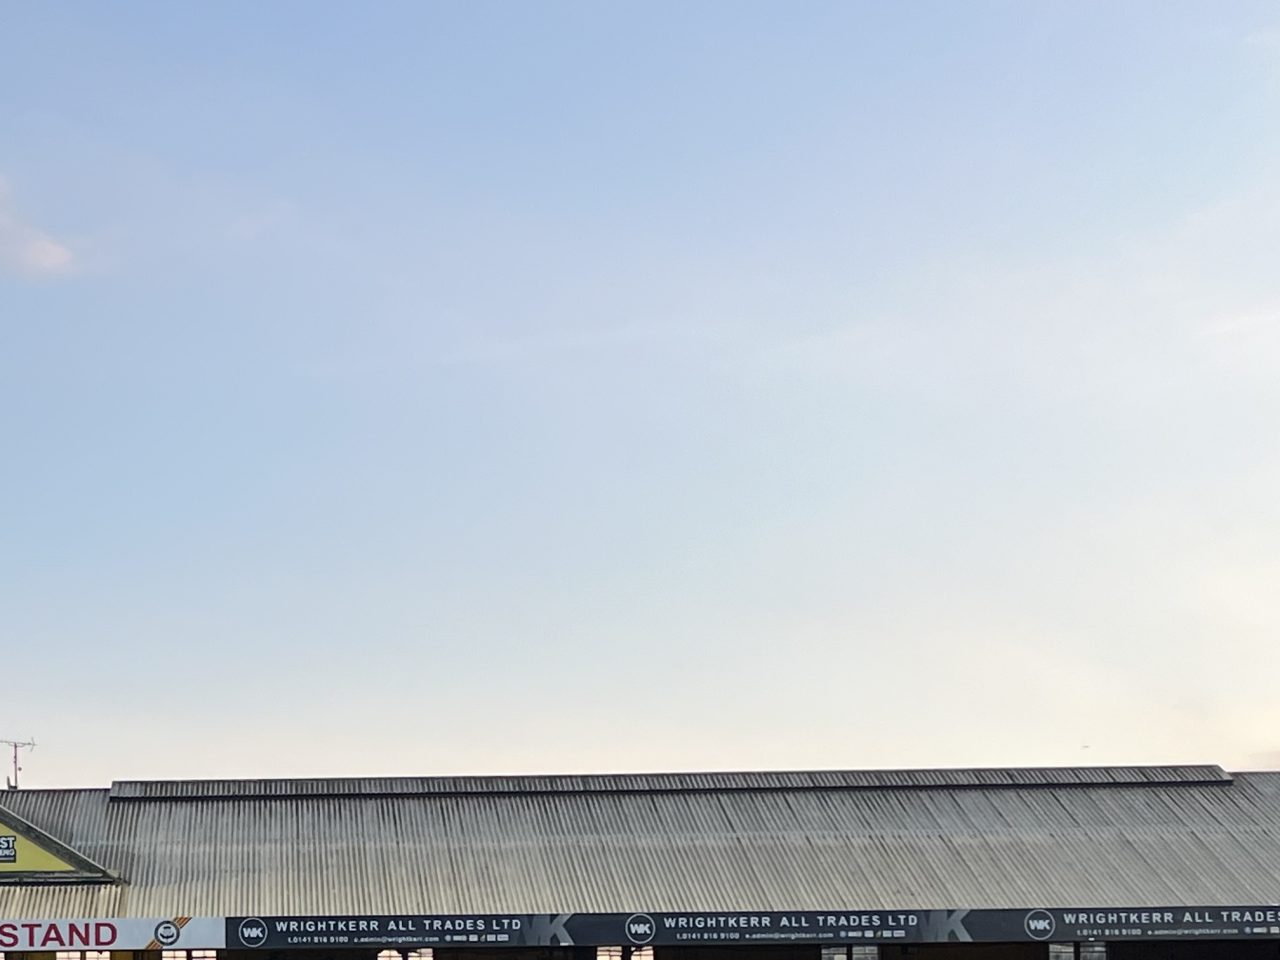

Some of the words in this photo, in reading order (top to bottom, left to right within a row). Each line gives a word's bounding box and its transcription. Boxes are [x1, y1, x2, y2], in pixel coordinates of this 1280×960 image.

[664, 916, 771, 928] WRIGHTKERR
[780, 916, 810, 927] ALL
[816, 916, 881, 926] TRADES
[888, 915, 918, 926] LTD
[1063, 912, 1174, 924] WRIGHTKERR
[1182, 912, 1214, 923] ALL
[275, 920, 379, 932] WRIGHTKERR
[387, 920, 416, 930] ALL
[423, 920, 485, 930] TRADES
[492, 920, 521, 930] LTD
